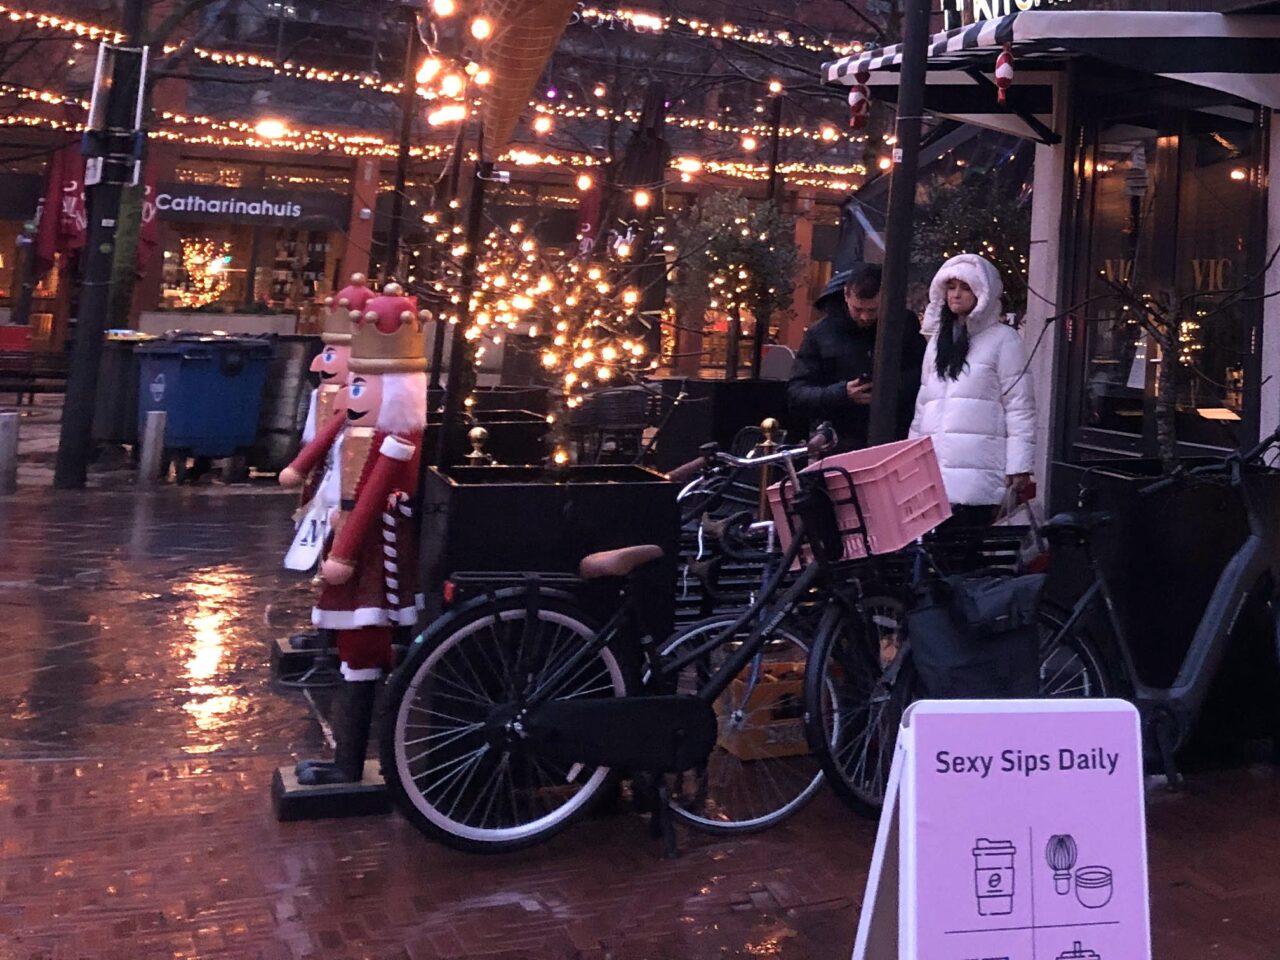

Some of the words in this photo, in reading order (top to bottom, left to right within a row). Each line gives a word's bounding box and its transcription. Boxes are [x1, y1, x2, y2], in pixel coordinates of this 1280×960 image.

[155, 194, 301, 218] Catharinahuis
[935, 750, 993, 778] Sexy
[1001, 749, 1050, 776] Sips
[1059, 747, 1119, 775] Daily
